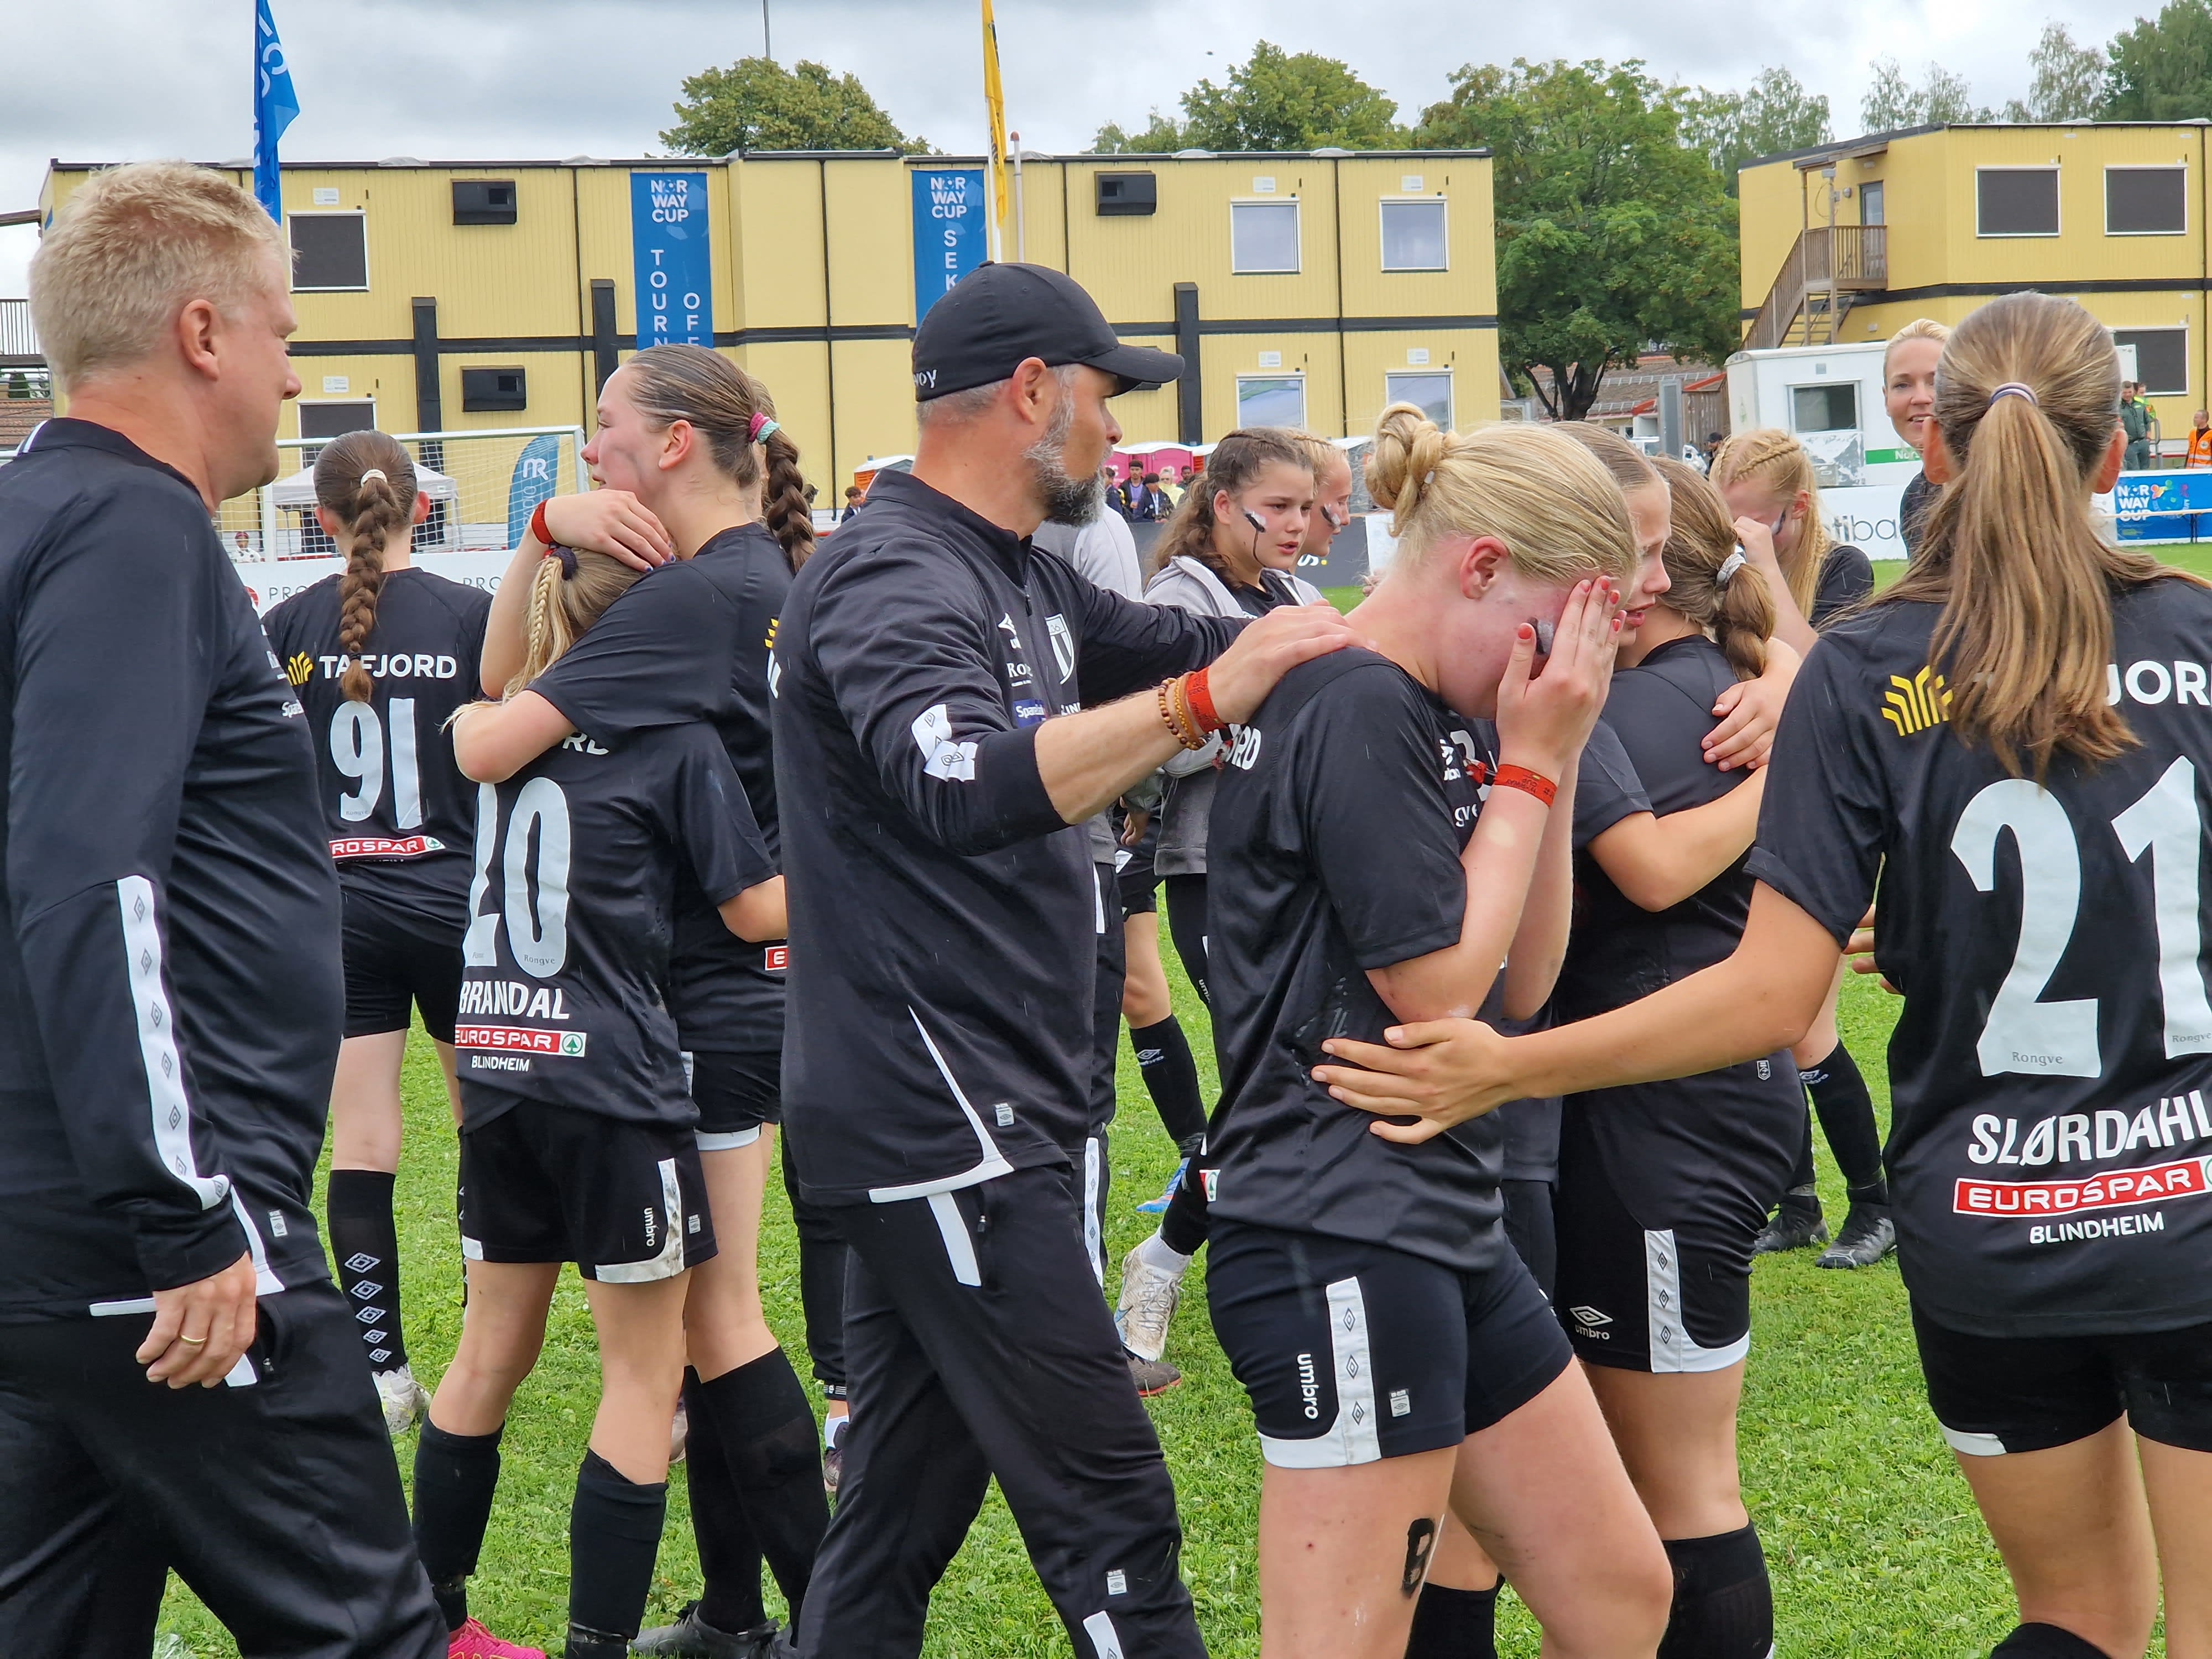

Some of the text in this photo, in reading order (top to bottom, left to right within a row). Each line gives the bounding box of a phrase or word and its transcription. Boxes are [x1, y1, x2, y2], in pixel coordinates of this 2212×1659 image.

[651, 194, 688, 208] WAY
[931, 191, 966, 204] WAY
[651, 208, 689, 223] CUP
[931, 205, 967, 218] CUP
[2118, 497, 2151, 509] WAY
[319, 654, 457, 679] TAFJORD
[2105, 660, 2212, 707] JOR
[330, 697, 423, 829] 91
[332, 840, 419, 855] ROSPAR
[1950, 755, 2212, 1078] 21
[524, 954, 556, 966] Rongve
[459, 980, 570, 1019] BRANDAL
[455, 1029, 552, 1050] EUROSPAR
[2172, 1031, 2212, 1044] Rongve
[471, 1055, 530, 1072] BLINDHEIM
[2012, 1051, 2064, 1066] Rongve
[1968, 1167, 2192, 1211] EUROSPAR
[644, 1207, 658, 1246] umbro
[2030, 1211, 2166, 1244] BLINDHEIM
[1574, 1324, 1610, 1340] umbro
[1297, 1353, 1319, 1420] umbro
